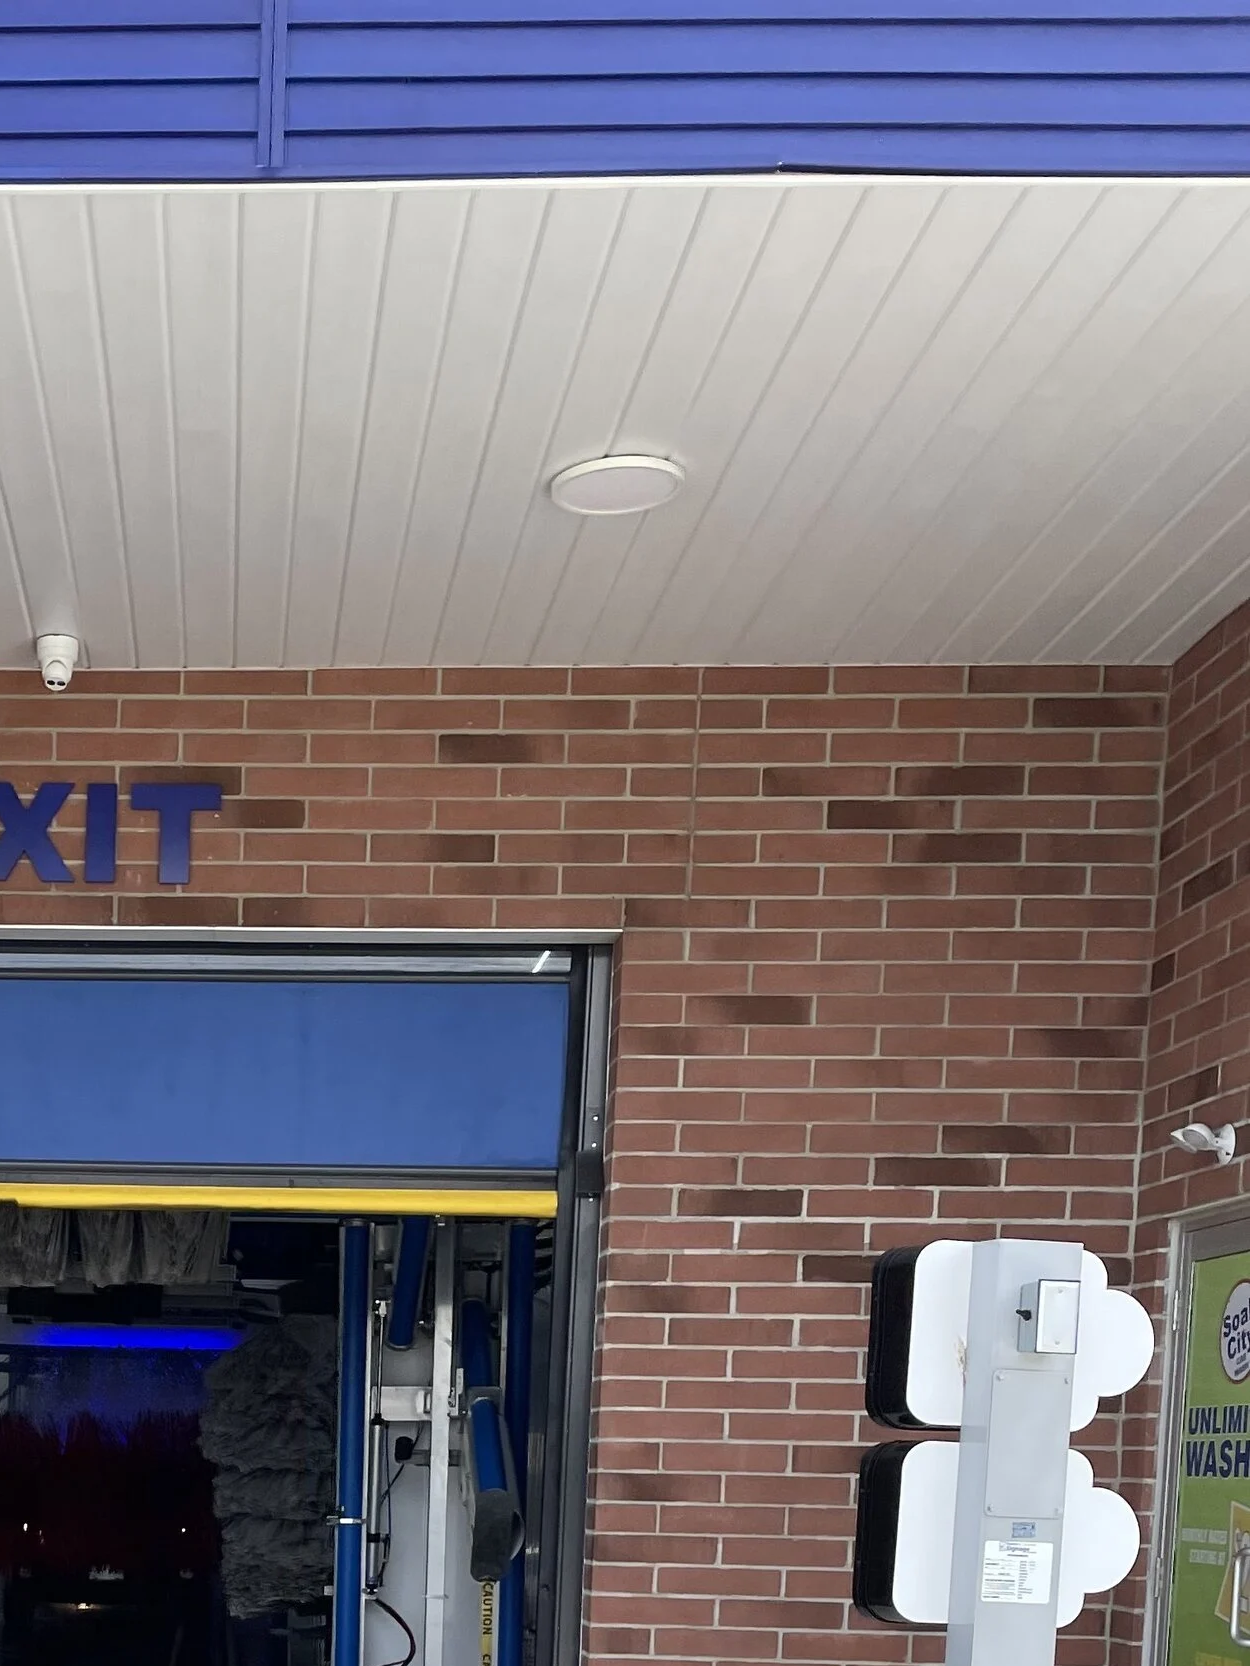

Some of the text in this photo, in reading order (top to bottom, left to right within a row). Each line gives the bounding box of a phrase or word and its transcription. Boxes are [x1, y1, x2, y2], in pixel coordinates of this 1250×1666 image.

[1223, 1297, 1250, 1338] Soa
[1185, 1440, 1250, 1478] WASH
[482, 1582, 494, 1635] CAUTION
